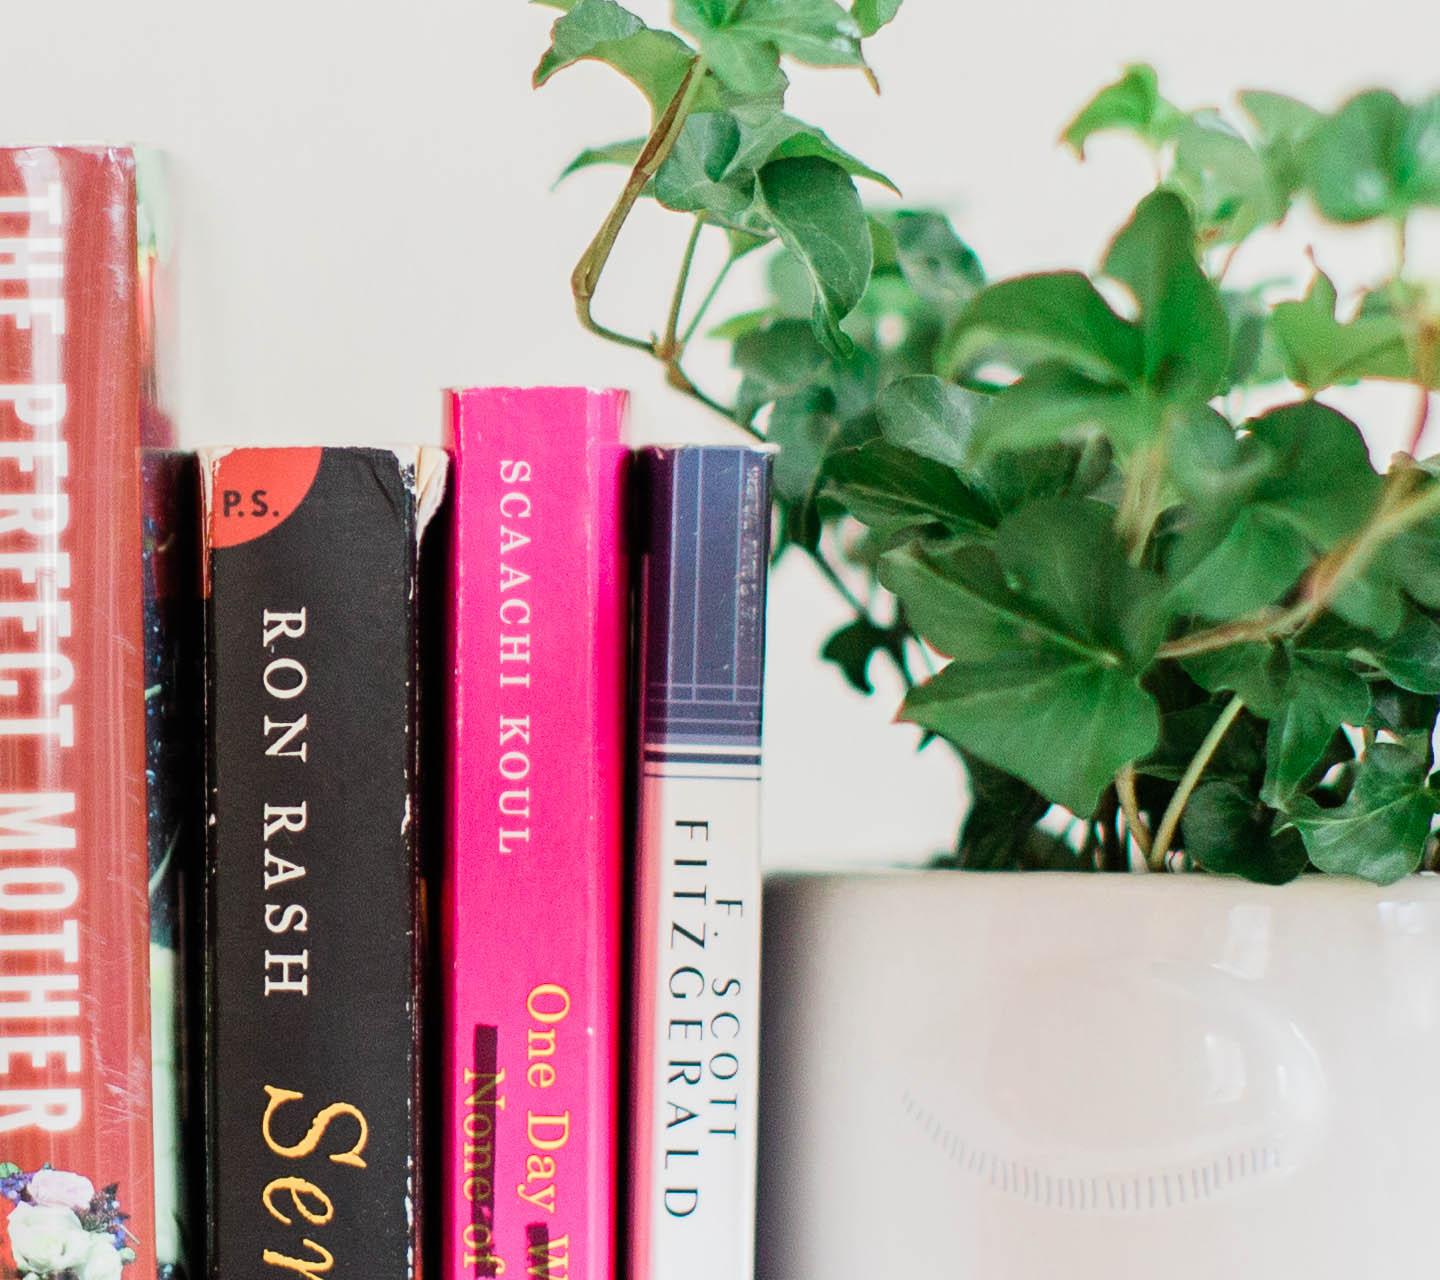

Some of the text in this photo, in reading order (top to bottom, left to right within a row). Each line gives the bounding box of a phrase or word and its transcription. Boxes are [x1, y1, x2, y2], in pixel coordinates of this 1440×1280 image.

[223, 489, 279, 517] P.S.
[499, 459, 531, 854] SCAACHI KOUL
[263, 607, 308, 996] RON RASH
[527, 984, 570, 1088] One
[664, 819, 709, 1218] FITZGERALD
[708, 977, 742, 1140] SCOTT
[463, 1068, 505, 1201] None
[518, 1111, 570, 1213] Day
[463, 1225, 504, 1274] of
